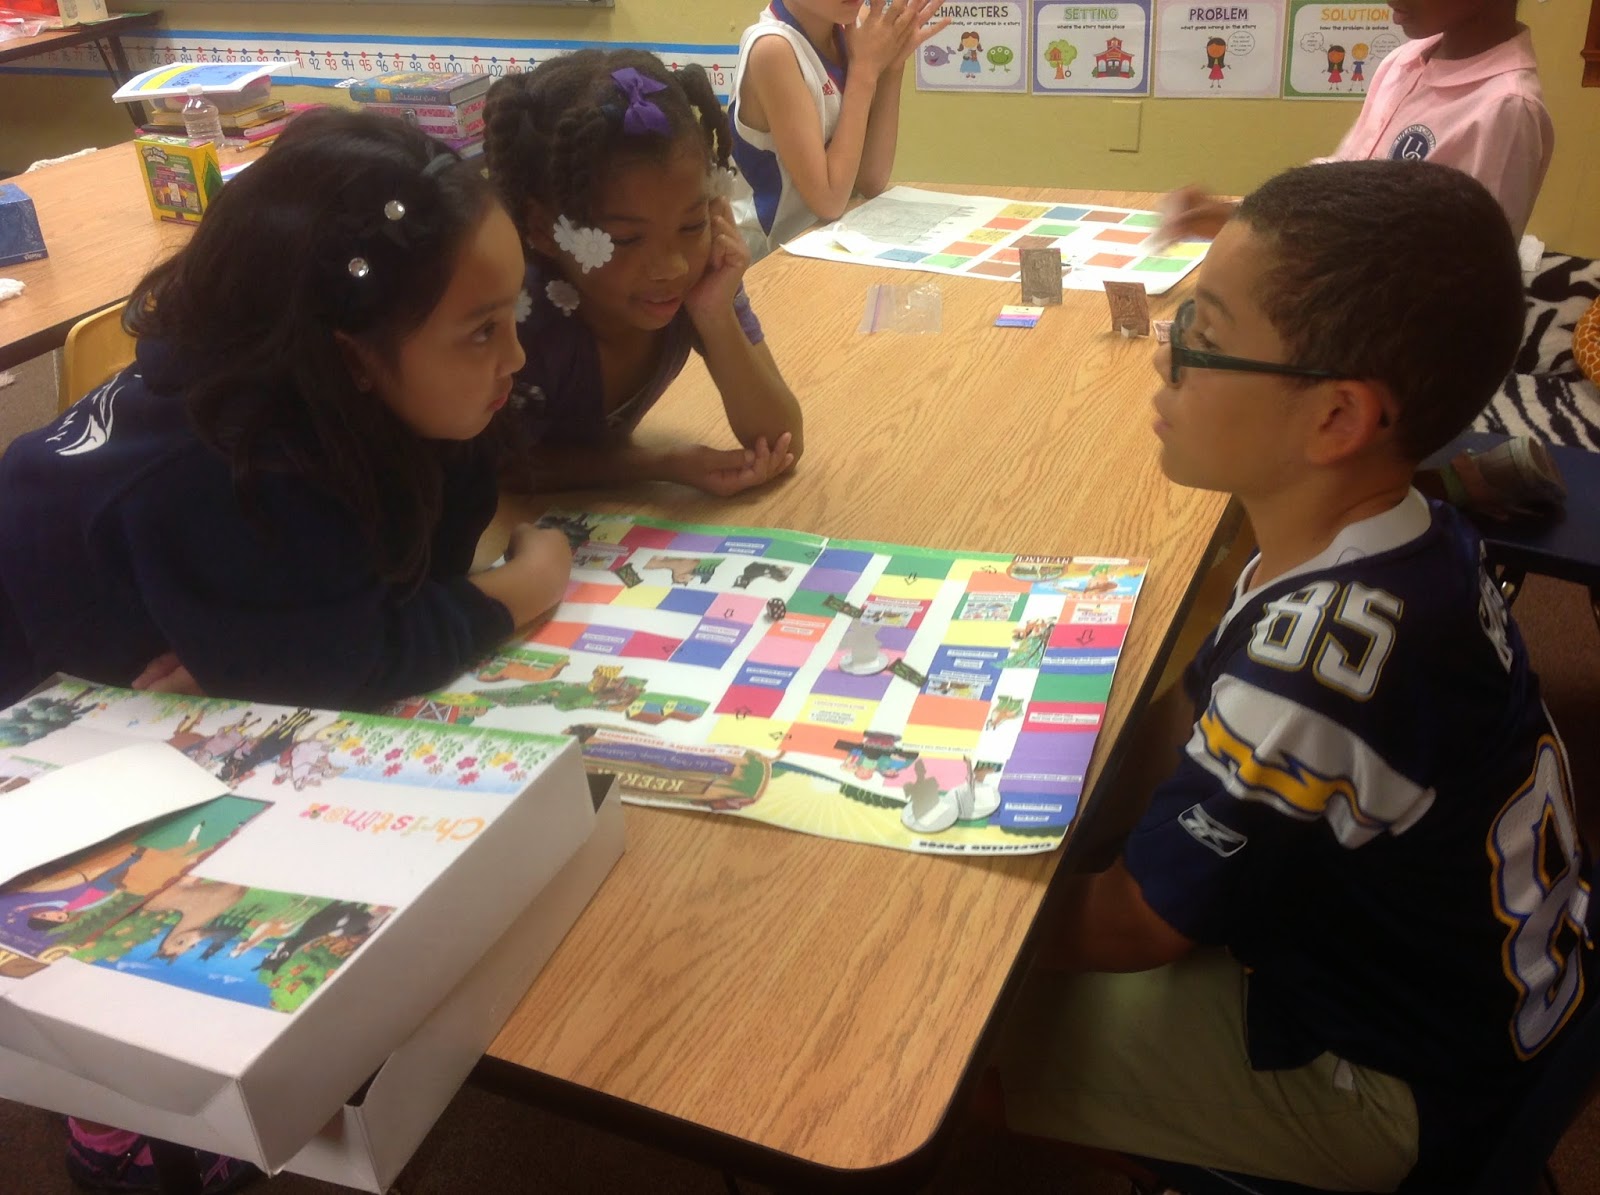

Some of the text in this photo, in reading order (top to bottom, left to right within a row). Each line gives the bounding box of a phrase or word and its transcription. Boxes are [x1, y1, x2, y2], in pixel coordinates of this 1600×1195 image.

[934, 5, 1009, 18] CHARACTERS
[1063, 7, 1119, 21] SETTING
[1189, 7, 1248, 20] PROBLEM
[1321, 7, 1390, 21] SOLUTION
[180, 53, 193, 63] 84
[211, 54, 223, 63] 86
[226, 54, 237, 63] 87
[308, 58, 321, 71] 92
[324, 58, 338, 71] 93
[341, 59, 355, 71] 94
[358, 59, 372, 72] 95
[375, 60, 389, 73] 96
[392, 60, 404, 72] 97
[409, 61, 423, 72] 98
[427, 61, 442, 72] 99
[444, 62, 463, 74] 100
[471, 63, 485, 75] 101
[487, 64, 504, 78] 102
[708, 71, 725, 86] 113
[1247, 579, 1405, 701] 85
